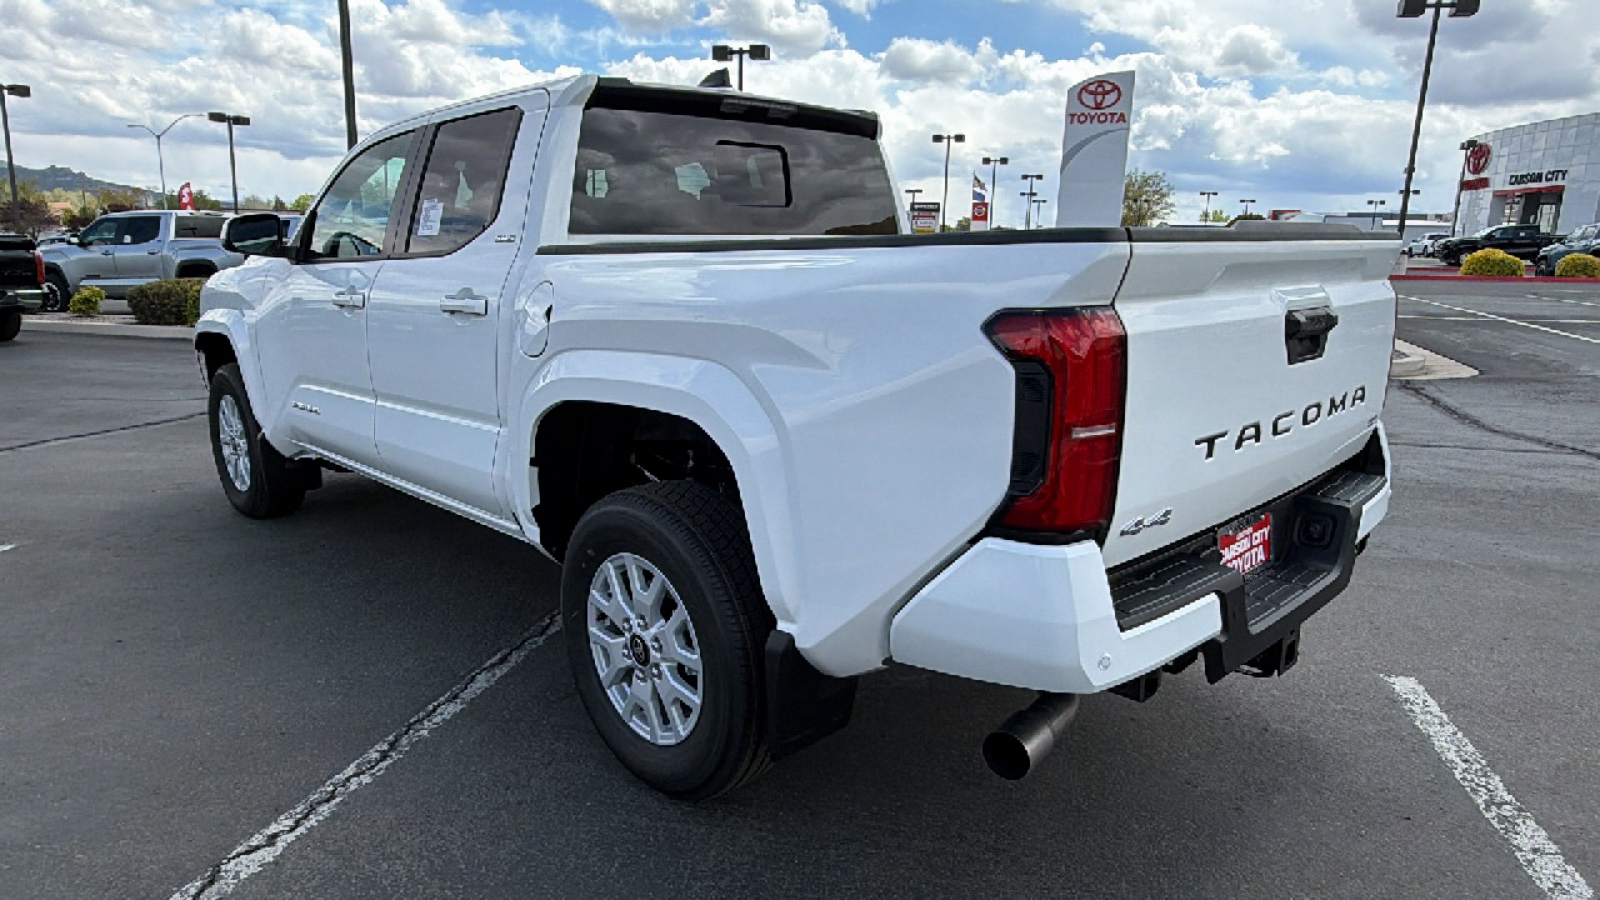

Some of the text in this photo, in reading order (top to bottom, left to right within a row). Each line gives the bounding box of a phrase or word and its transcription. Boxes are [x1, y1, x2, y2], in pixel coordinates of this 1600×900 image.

[1069, 111, 1127, 125] TOYOTA
[1509, 169, 1568, 186] CARSON CITY
[1194, 384, 1367, 461] TACOMA
[1252, 525, 1270, 546] CITY
[1226, 545, 1265, 573] OYOTA
